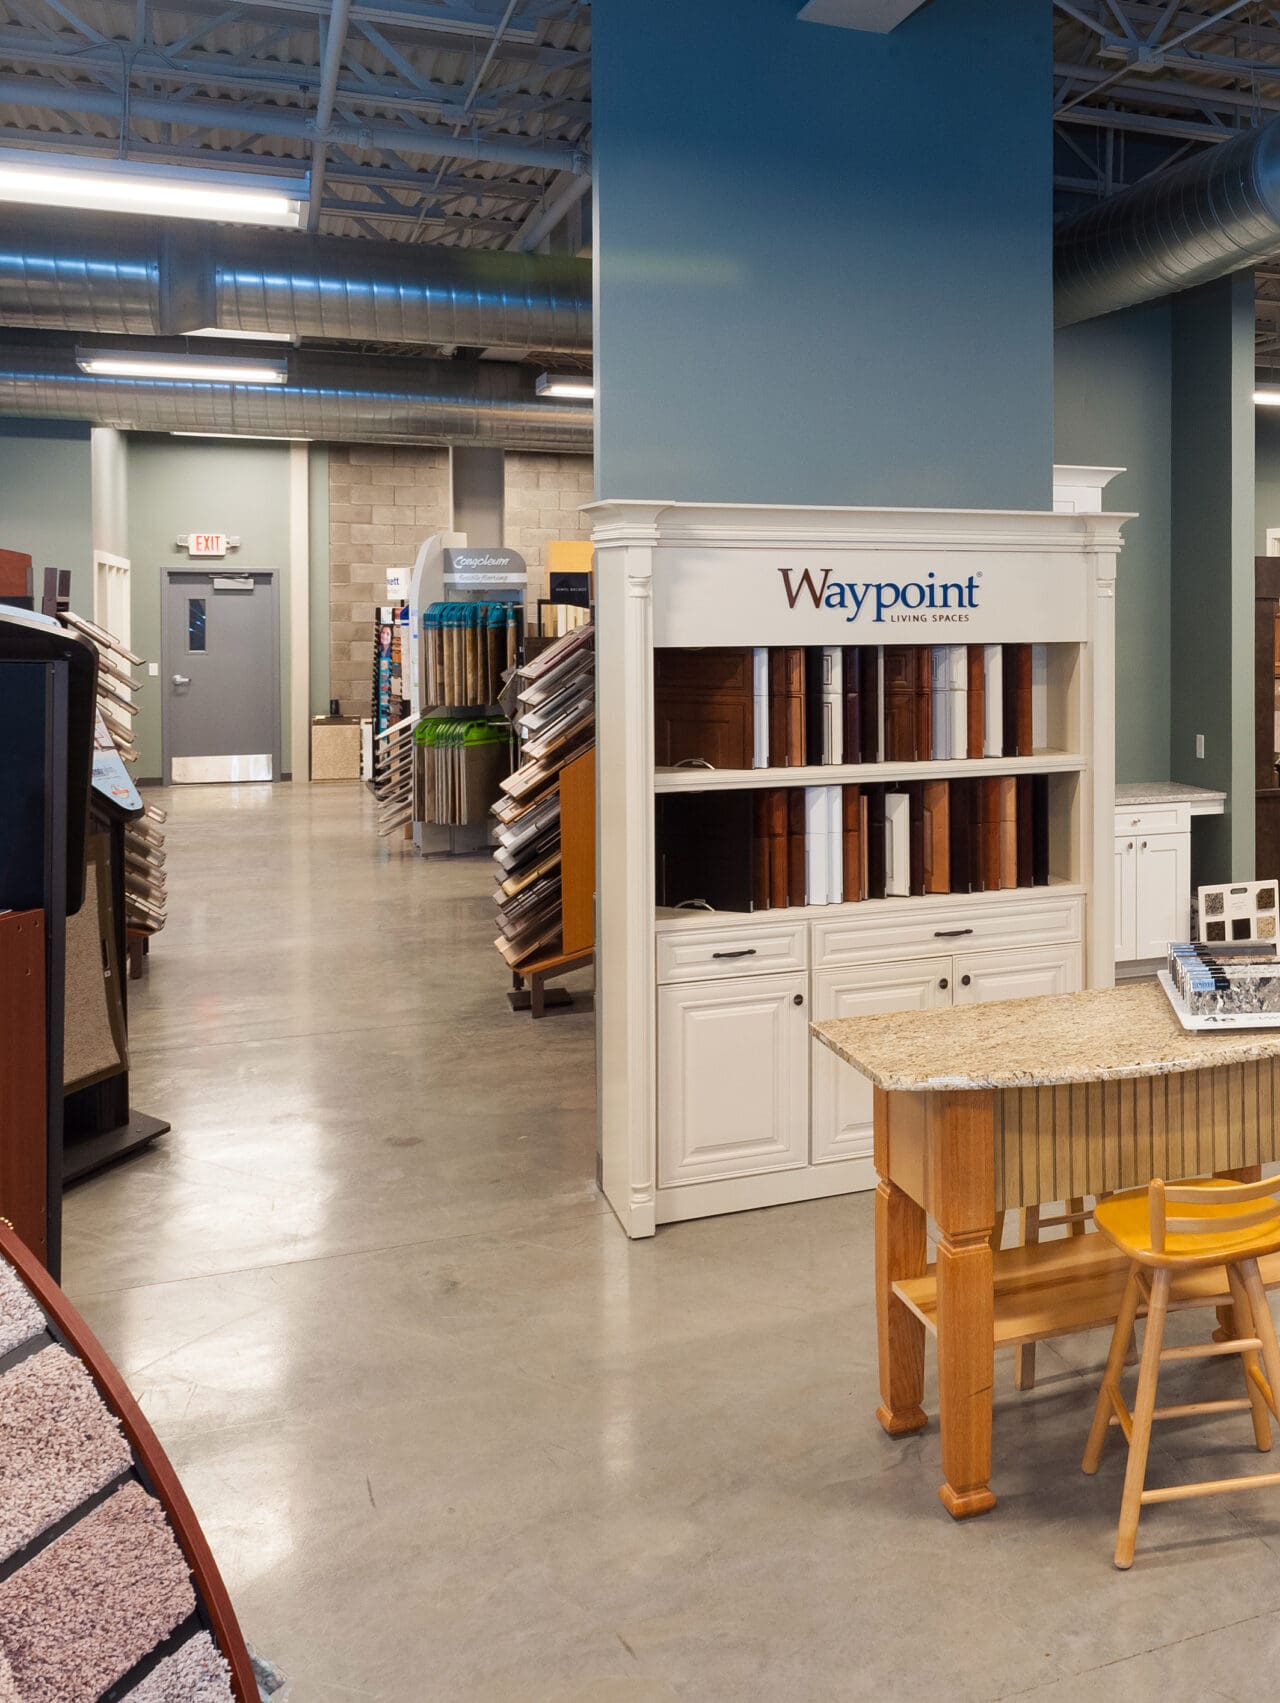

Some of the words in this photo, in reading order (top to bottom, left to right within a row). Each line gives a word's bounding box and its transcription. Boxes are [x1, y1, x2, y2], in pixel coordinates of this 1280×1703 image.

[196, 535, 221, 552] EXIT
[453, 554, 511, 569] Congoleum
[890, 614, 928, 623] LIVING
[931, 614, 970, 623] SPACES
